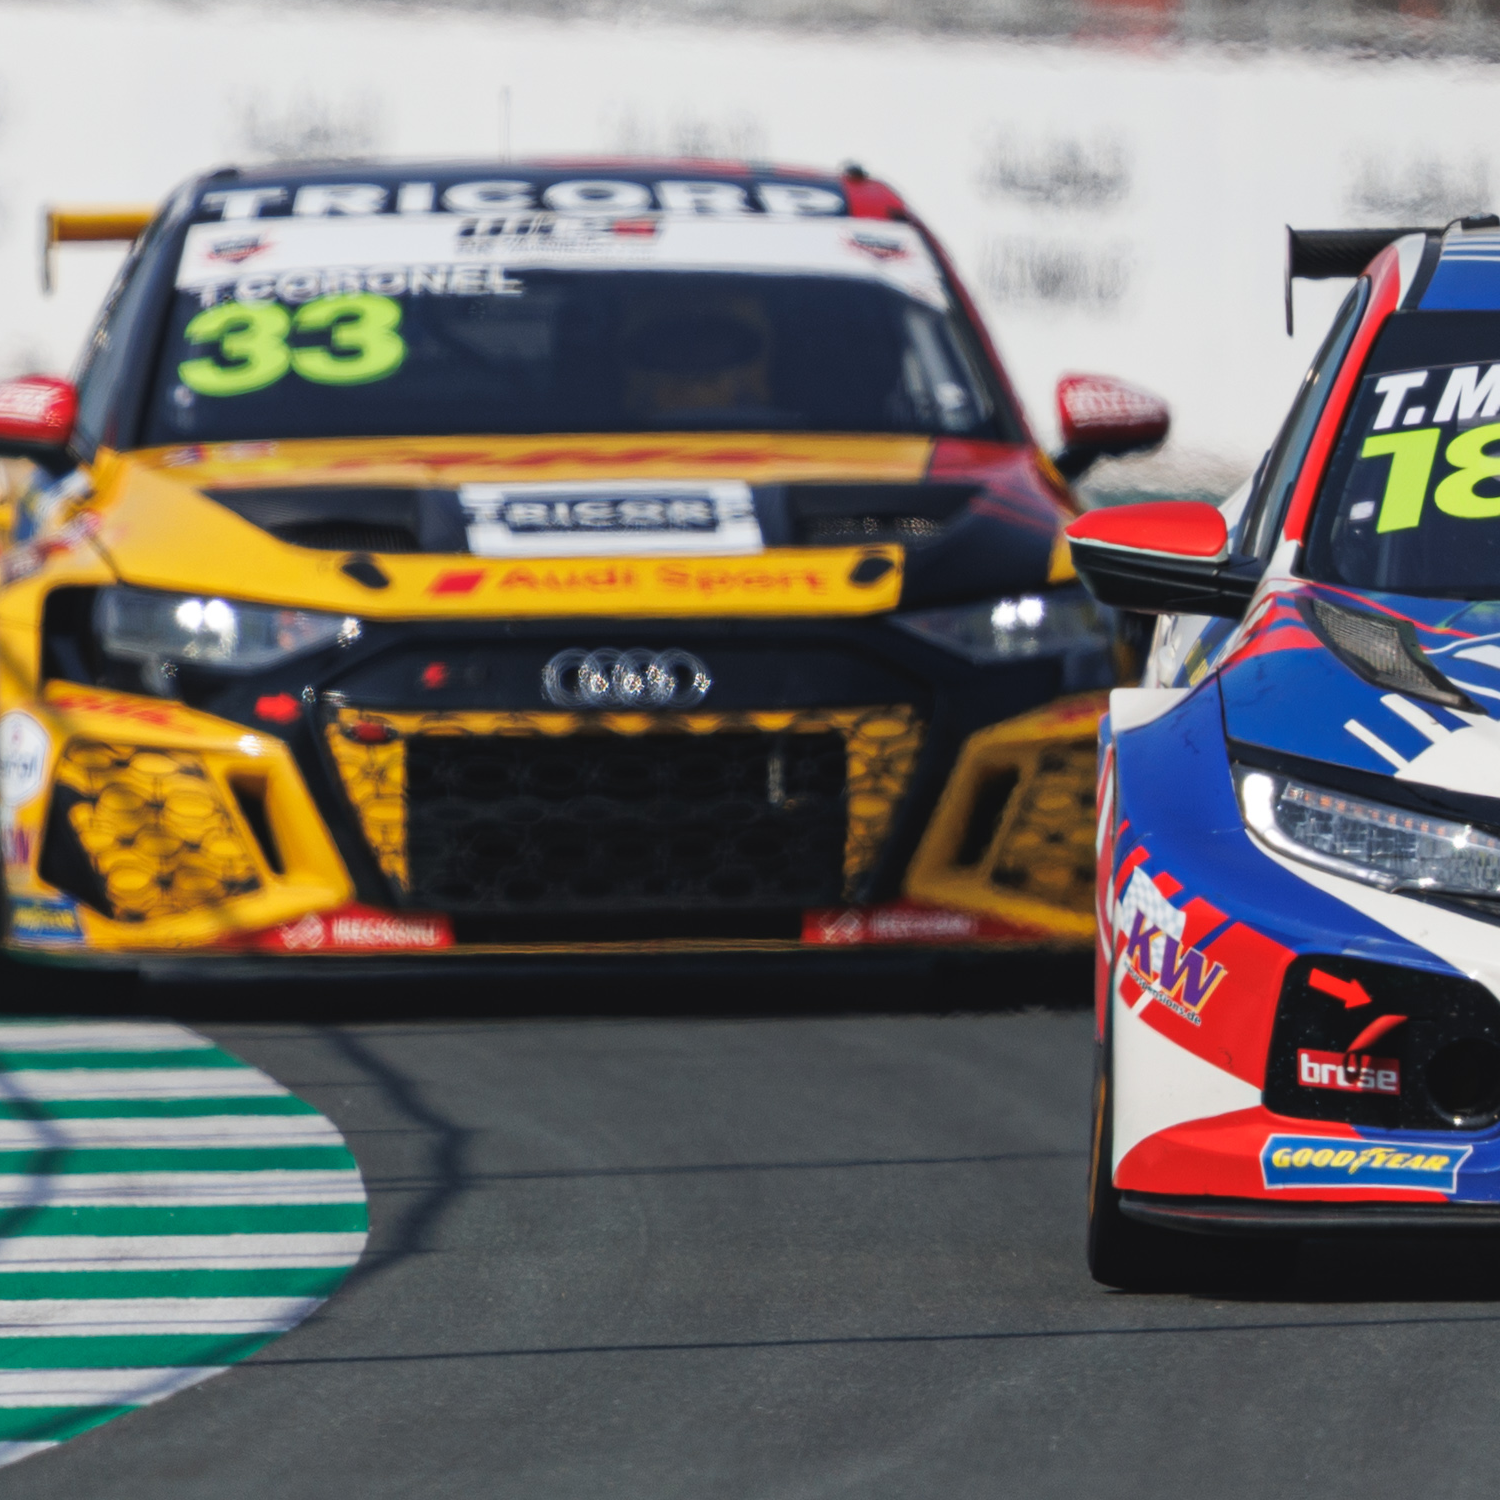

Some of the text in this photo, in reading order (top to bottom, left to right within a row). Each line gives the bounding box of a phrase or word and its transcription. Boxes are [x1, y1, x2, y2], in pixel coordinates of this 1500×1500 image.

[200, 178, 847, 222] TRICORP
[178, 293, 406, 396] 33
[500, 565, 830, 596] Audi Sport
[1126, 906, 1229, 1020] KW
